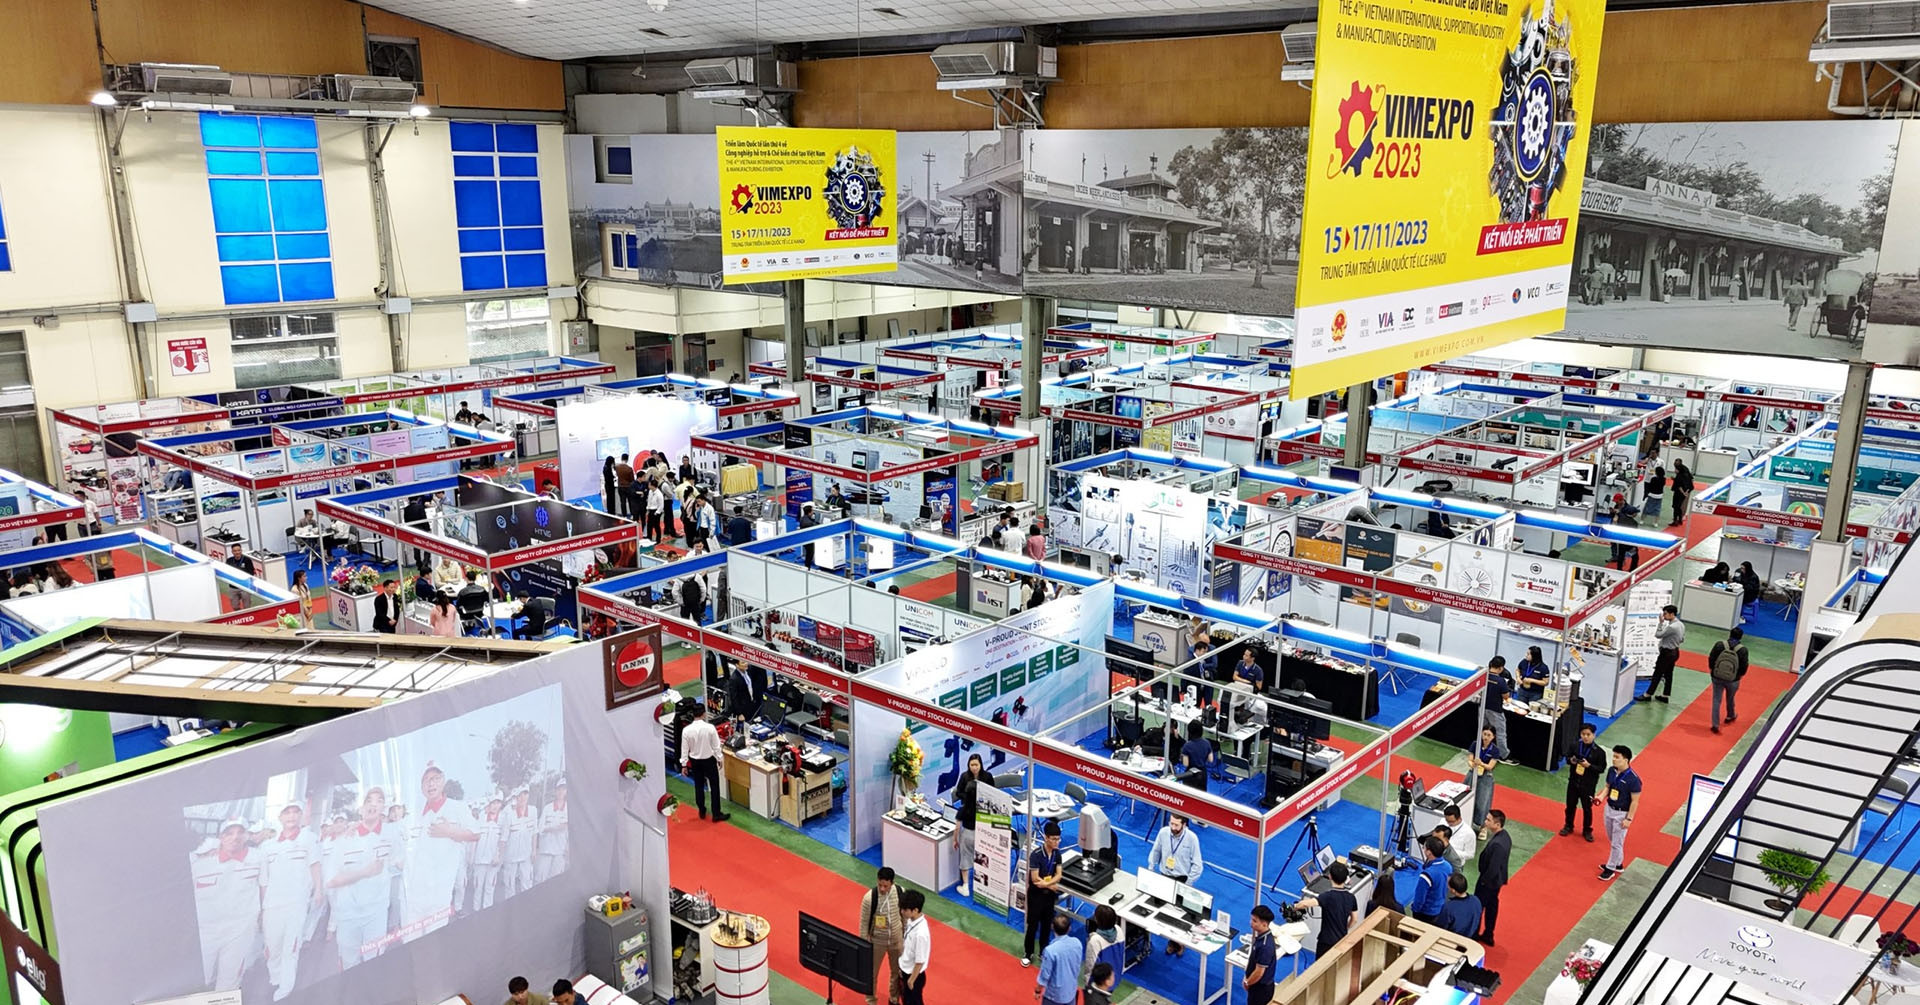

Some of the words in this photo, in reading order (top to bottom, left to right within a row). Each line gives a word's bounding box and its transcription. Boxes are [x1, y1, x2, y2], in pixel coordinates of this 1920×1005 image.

[1493, 2, 1508, 16] Nam
[1339, 0, 1352, 15] THE
[1364, 4, 1394, 23] VIETNAM
[1395, 10, 1442, 31] INTERNATIONAL
[1444, 18, 1478, 36] SUPPORTING
[1479, 24, 1505, 40] INDUSTRY
[1336, 23, 1342, 38] &
[1343, 25, 1402, 47] MANUFACTURING
[1402, 34, 1436, 51] EXHIBITION
[1386, 94, 1474, 140] VIMEXPO
[1374, 142, 1421, 178] 2023
[757, 186, 812, 200] VIMEXPO
[754, 202, 782, 214] 2023
[731, 230, 741, 238] 15
[747, 228, 791, 238] 17/11/2023
[1325, 227, 1342, 253] 15
[1354, 220, 1428, 250] 17/11/2023
[1484, 226, 1499, 249] KẾT
[1499, 225, 1514, 247] NỐI
[1513, 223, 1527, 245] ĐỂ
[1524, 224, 1543, 244] PHÁT
[1543, 220, 1562, 241] TRIỂN
[1320, 265, 1343, 280] TRUNG
[1345, 261, 1358, 277] TÂM
[1378, 311, 1394, 329] VIA
[236, 408, 262, 416] KATA
[894, 481, 903, 490] 01
[1746, 515, 1781, 524] AUTOMATION
[1791, 516, 1822, 525] INDUSTRIAL
[1272, 562, 1292, 572] SETSUBI
[1292, 566, 1304, 574] VIỆT
[1274, 555, 1288, 564] THIẾT
[1308, 564, 1328, 573] NGHIỆP
[905, 604, 934, 616] UNICOM
[987, 598, 1004, 608] MST
[1414, 587, 1431, 595] CÔNG
[1439, 591, 1455, 600] TNHH
[1455, 594, 1472, 604] THIẾT
[1479, 600, 1496, 608] CÔNG
[1496, 604, 1518, 615] NGHIỆP
[1432, 596, 1451, 605] NIHON
[1452, 601, 1475, 611] SETSUBI
[1475, 605, 1489, 614] VIỆT
[228, 616, 254, 625] LIMITED
[985, 630, 1014, 647] V-PROUD
[735, 649, 746, 657] PHÁT
[747, 652, 759, 661] TRIỂN
[760, 658, 778, 668] UNICOM
[781, 666, 800, 676] UNICOM
[742, 645, 755, 654] CÔNG
[768, 653, 781, 662] PHẦN
[622, 657, 649, 671] ANMI
[887, 698, 911, 711] V-PROUD
[911, 706, 926, 717] JOINT
[927, 712, 945, 723] STOCK
[945, 718, 973, 732] COMPANY
[1076, 763, 1105, 779] V-PROUD
[1106, 773, 1126, 786] JOINT
[1126, 780, 1149, 794] STOCK
[1150, 788, 1184, 807] COMPANY
[1233, 818, 1244, 827] 82
[1729, 941, 1776, 963] TOYOTA
[1696, 948, 1735, 966] Move
[1736, 966, 1767, 976] your
